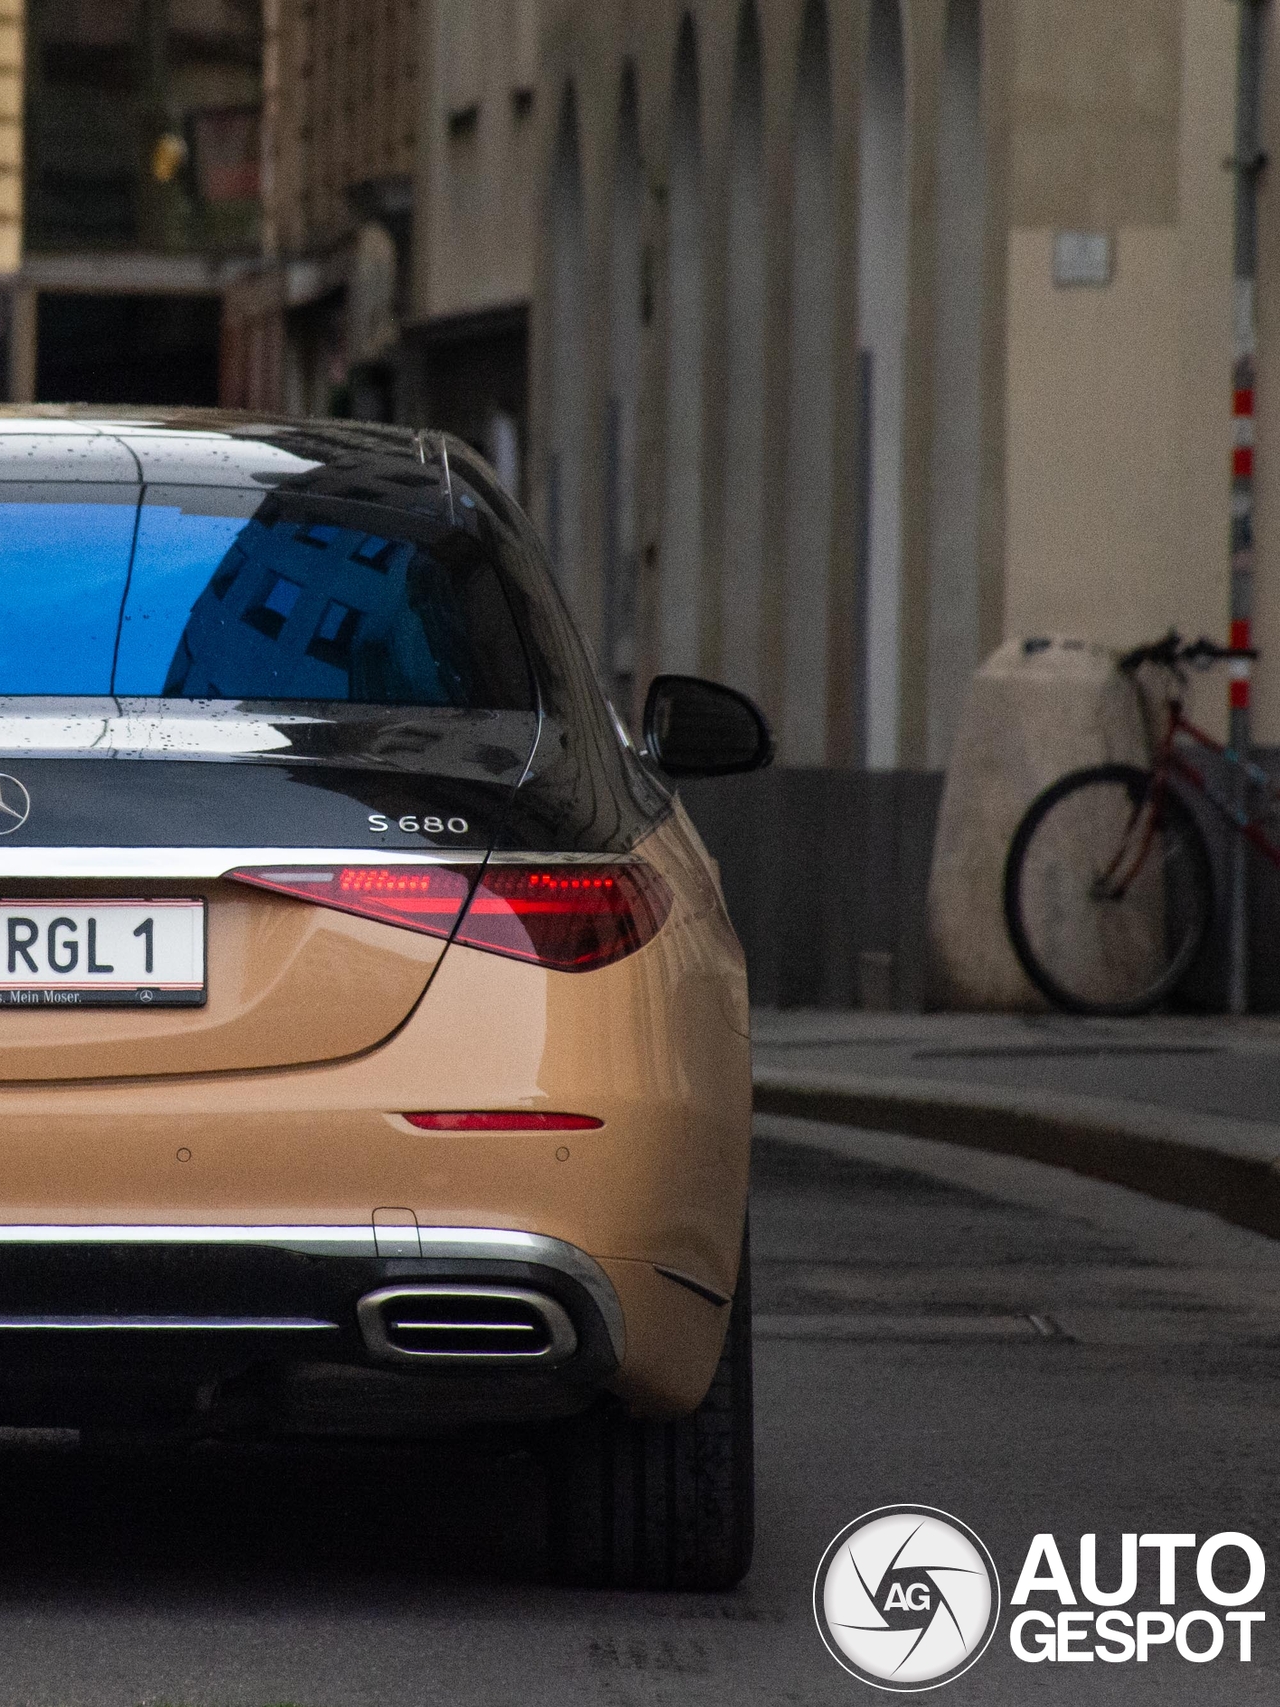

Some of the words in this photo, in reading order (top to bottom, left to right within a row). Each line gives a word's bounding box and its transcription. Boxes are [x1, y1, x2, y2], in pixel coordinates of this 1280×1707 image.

[368, 814, 389, 832] S
[398, 815, 469, 834] 680
[132, 917, 155, 974] 1
[10, 990, 40, 1004] Mein
[43, 990, 82, 1004] Moser.
